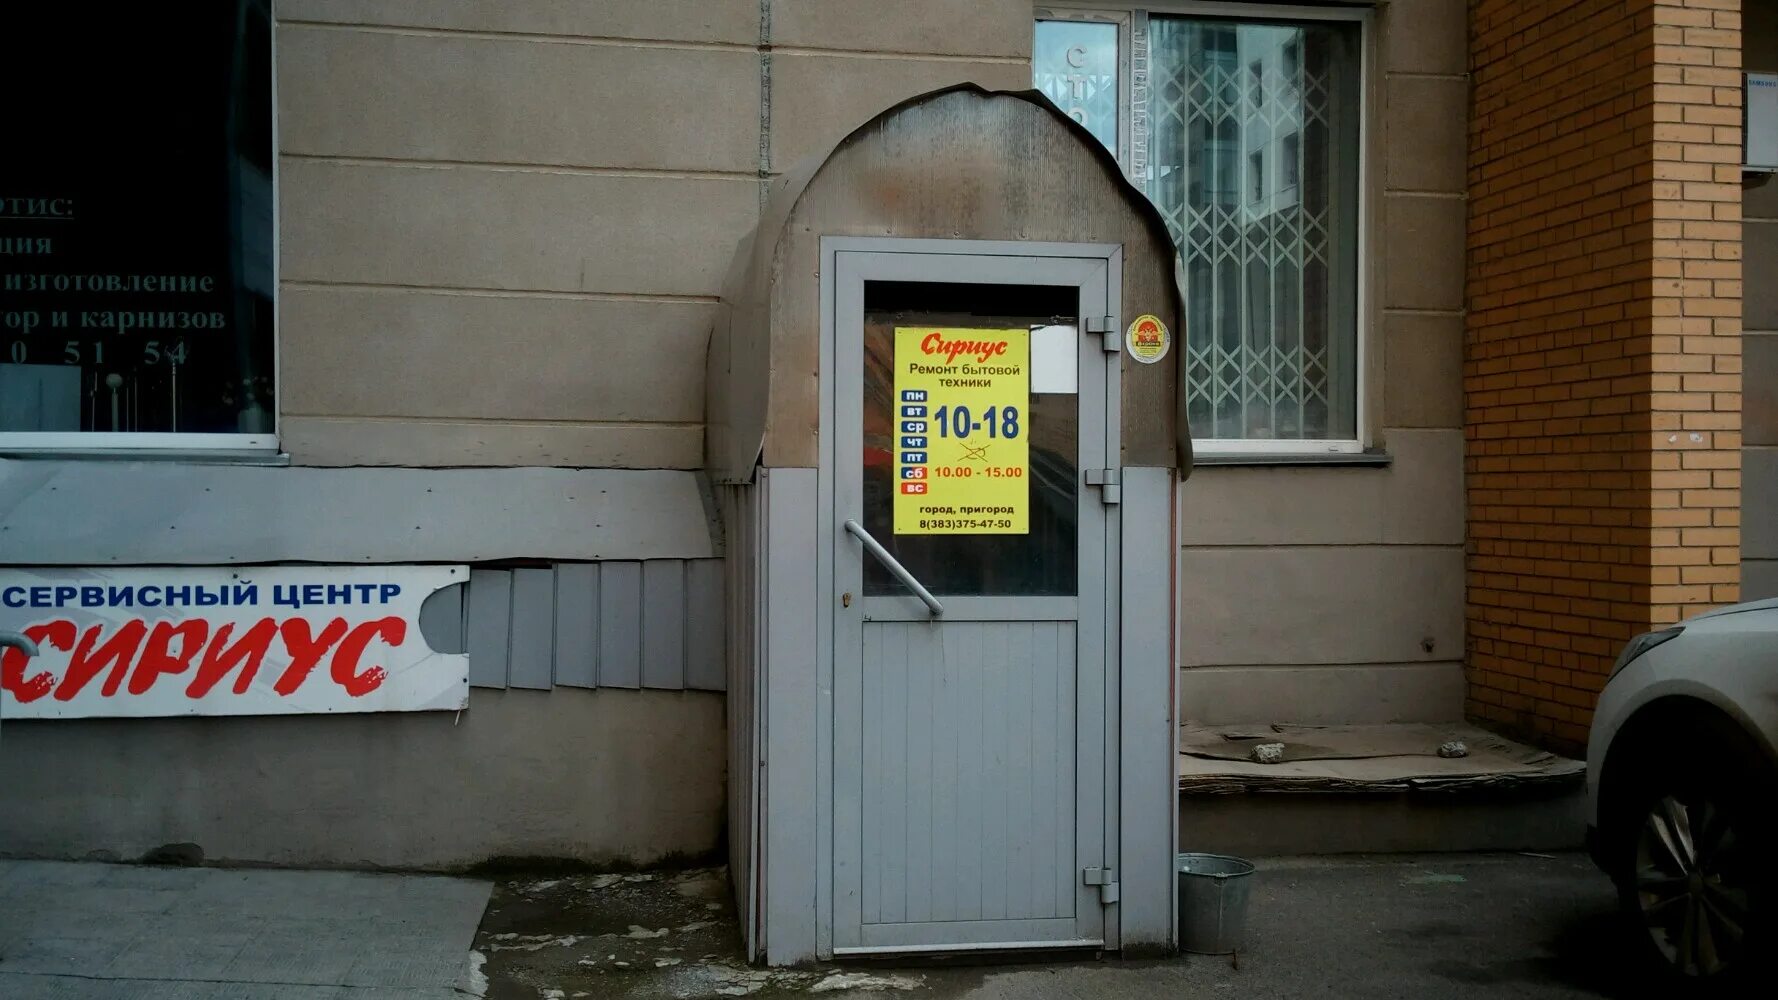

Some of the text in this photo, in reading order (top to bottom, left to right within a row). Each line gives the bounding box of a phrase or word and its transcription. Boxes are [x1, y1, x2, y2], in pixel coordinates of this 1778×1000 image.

[1748, 79, 1777, 88] SAMSUNG
[5, 274, 215, 293] изготовление
[0, 311, 226, 334] ор и карнизов
[920, 332, 1008, 364] Сириус
[909, 363, 1020, 376] Ремонт бытовой
[939, 379, 992, 387] техники
[934, 405, 1019, 439] 10-18
[934, 467, 972, 477] 10.00
[985, 467, 1022, 477] 15.00
[919, 506, 1015, 515] город, пригород
[919, 519, 1011, 530] 8(383)375-47-50
[2, 580, 401, 609] СЕРВИСНЫЙ ЦЕНТР
[1, 616, 408, 704] СИРИУС
